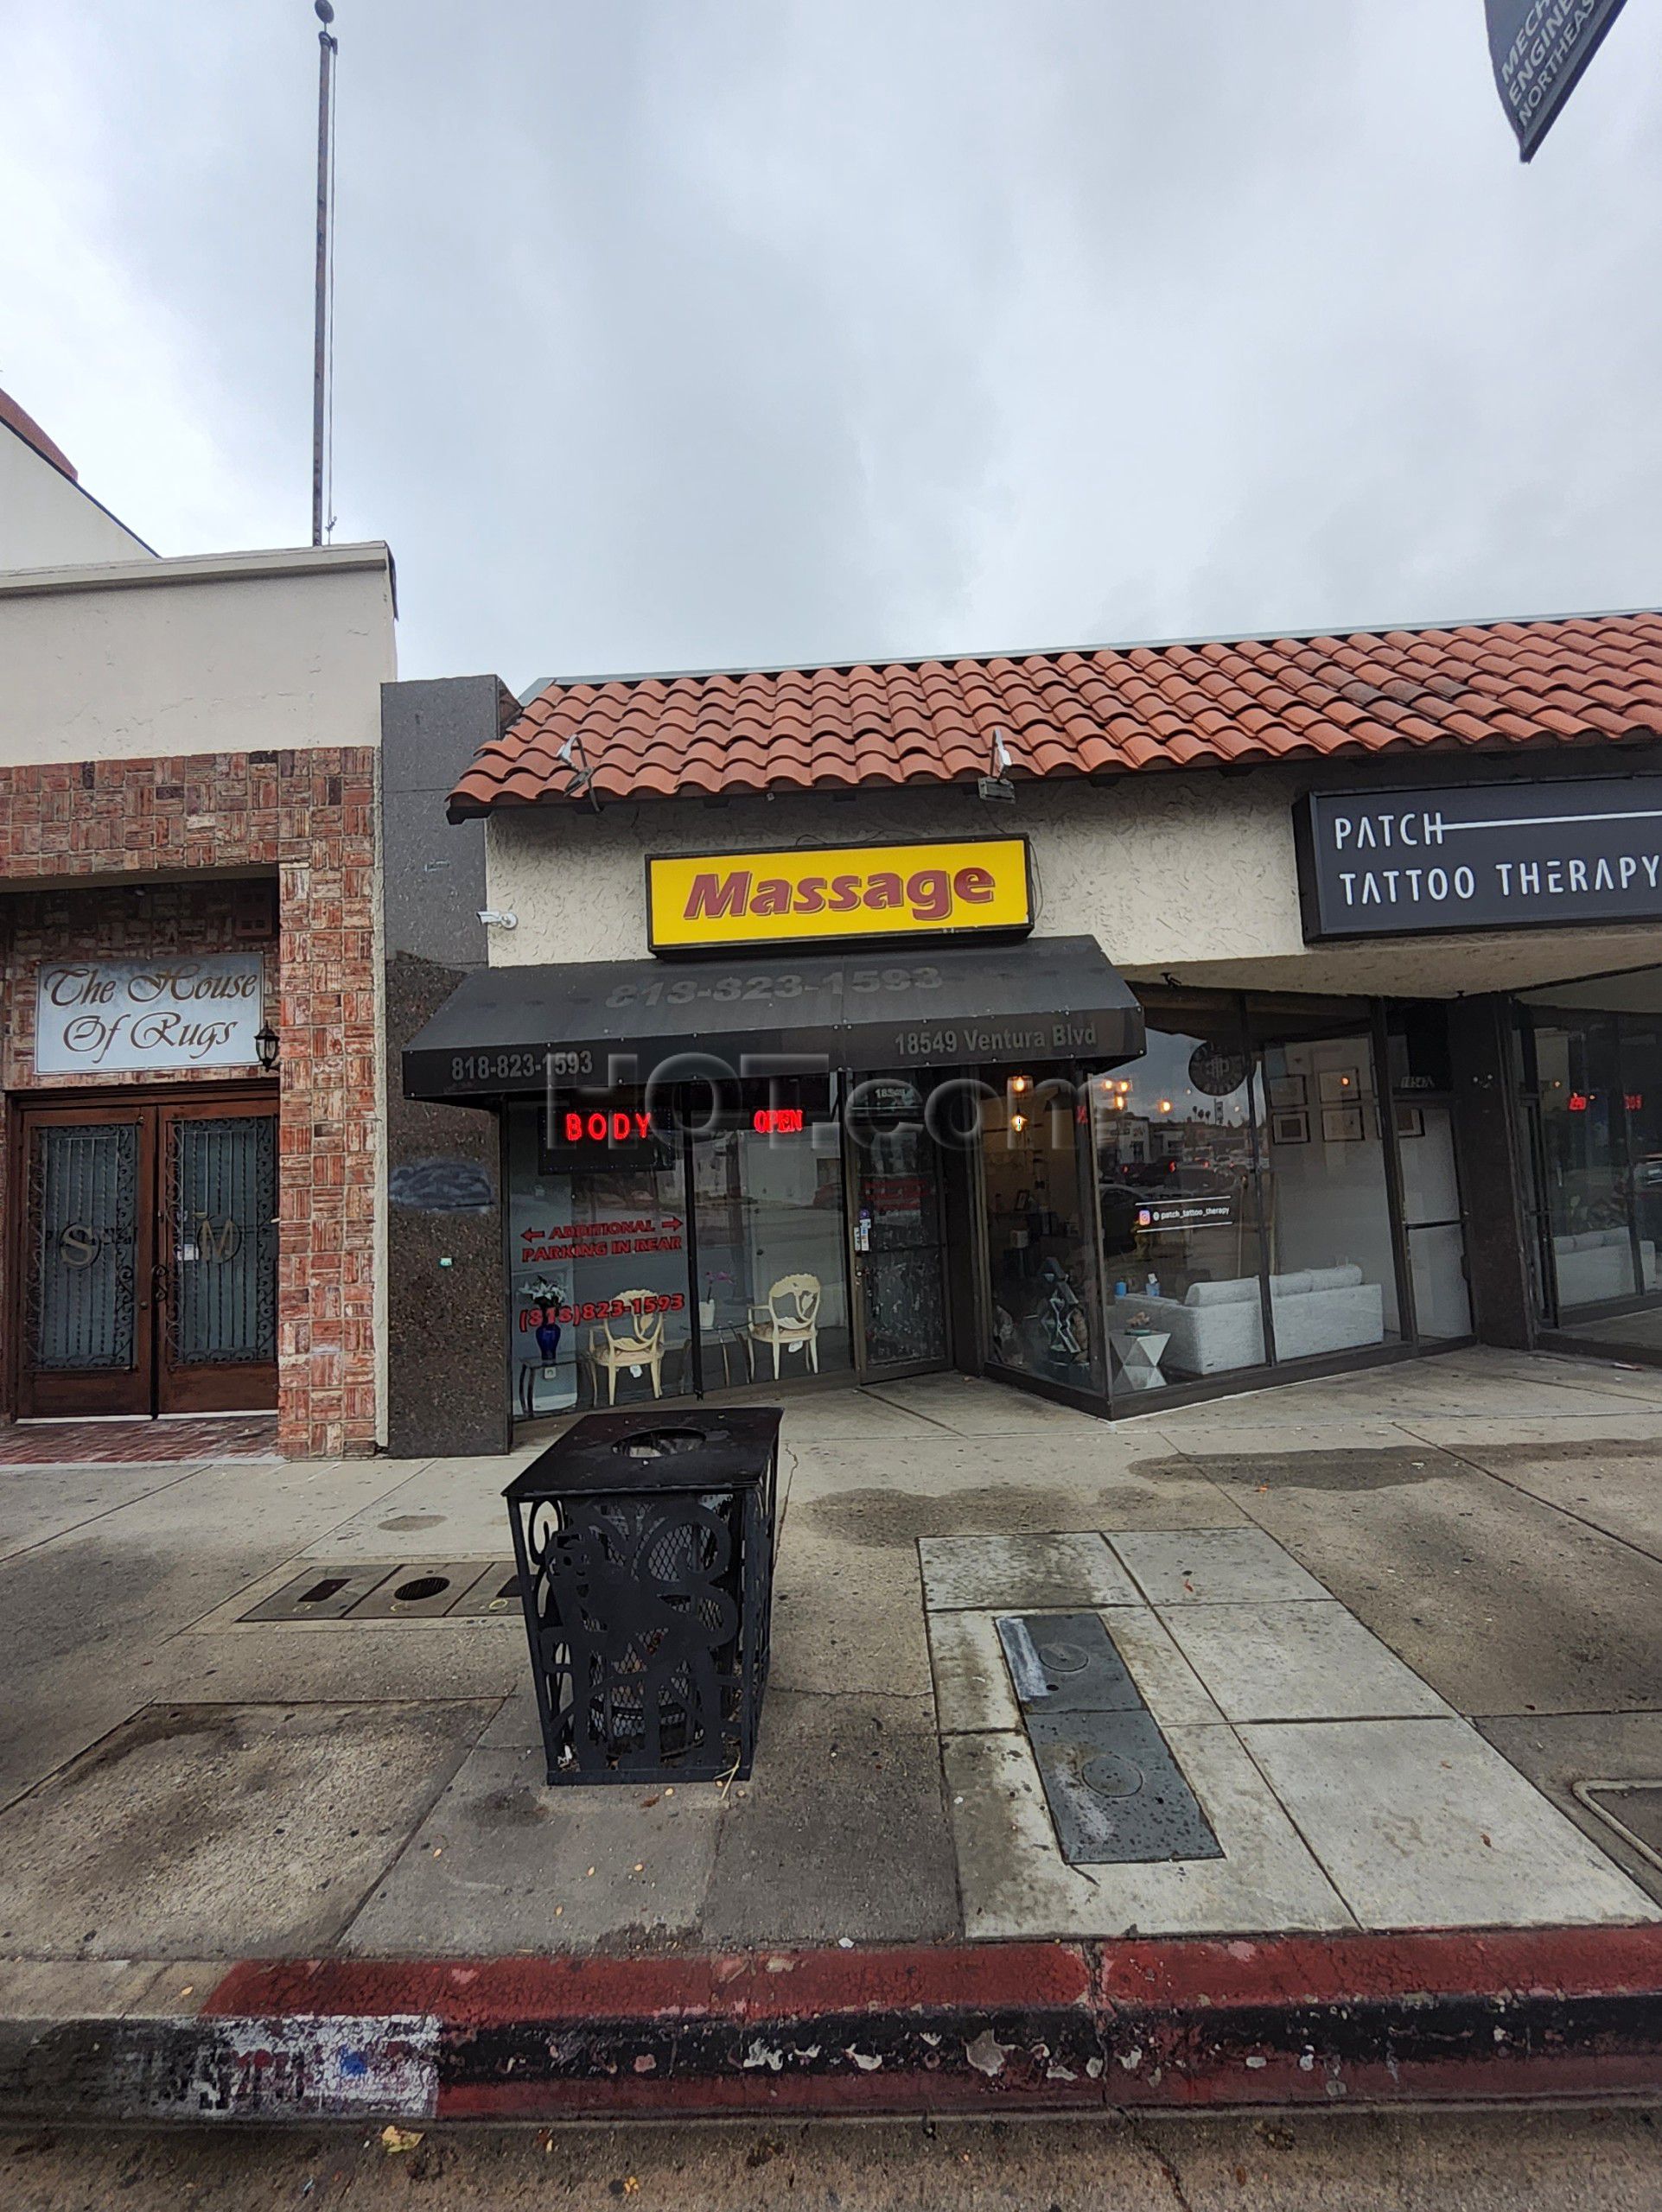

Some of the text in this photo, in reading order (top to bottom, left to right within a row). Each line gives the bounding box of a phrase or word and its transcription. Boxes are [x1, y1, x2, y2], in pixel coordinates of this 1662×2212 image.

[1334, 812, 1443, 850] PATCH
[683, 867, 995, 920] Massage
[1339, 855, 1660, 906] TATTOO THERAPY
[44, 963, 258, 1007] The House
[63, 1011, 239, 1064] Of Rugs
[895, 1023, 1097, 1056] 18549 Ventura Blvd
[451, 1051, 593, 1080] 818-823-1593
[565, 1112, 652, 1141] BODY
[754, 1109, 803, 1134] OPEN
[549, 1219, 655, 1239] ADDITIONAL
[522, 1236, 682, 1262] PARKING IN REAR
[519, 1294, 685, 1332] (818)823-1593
